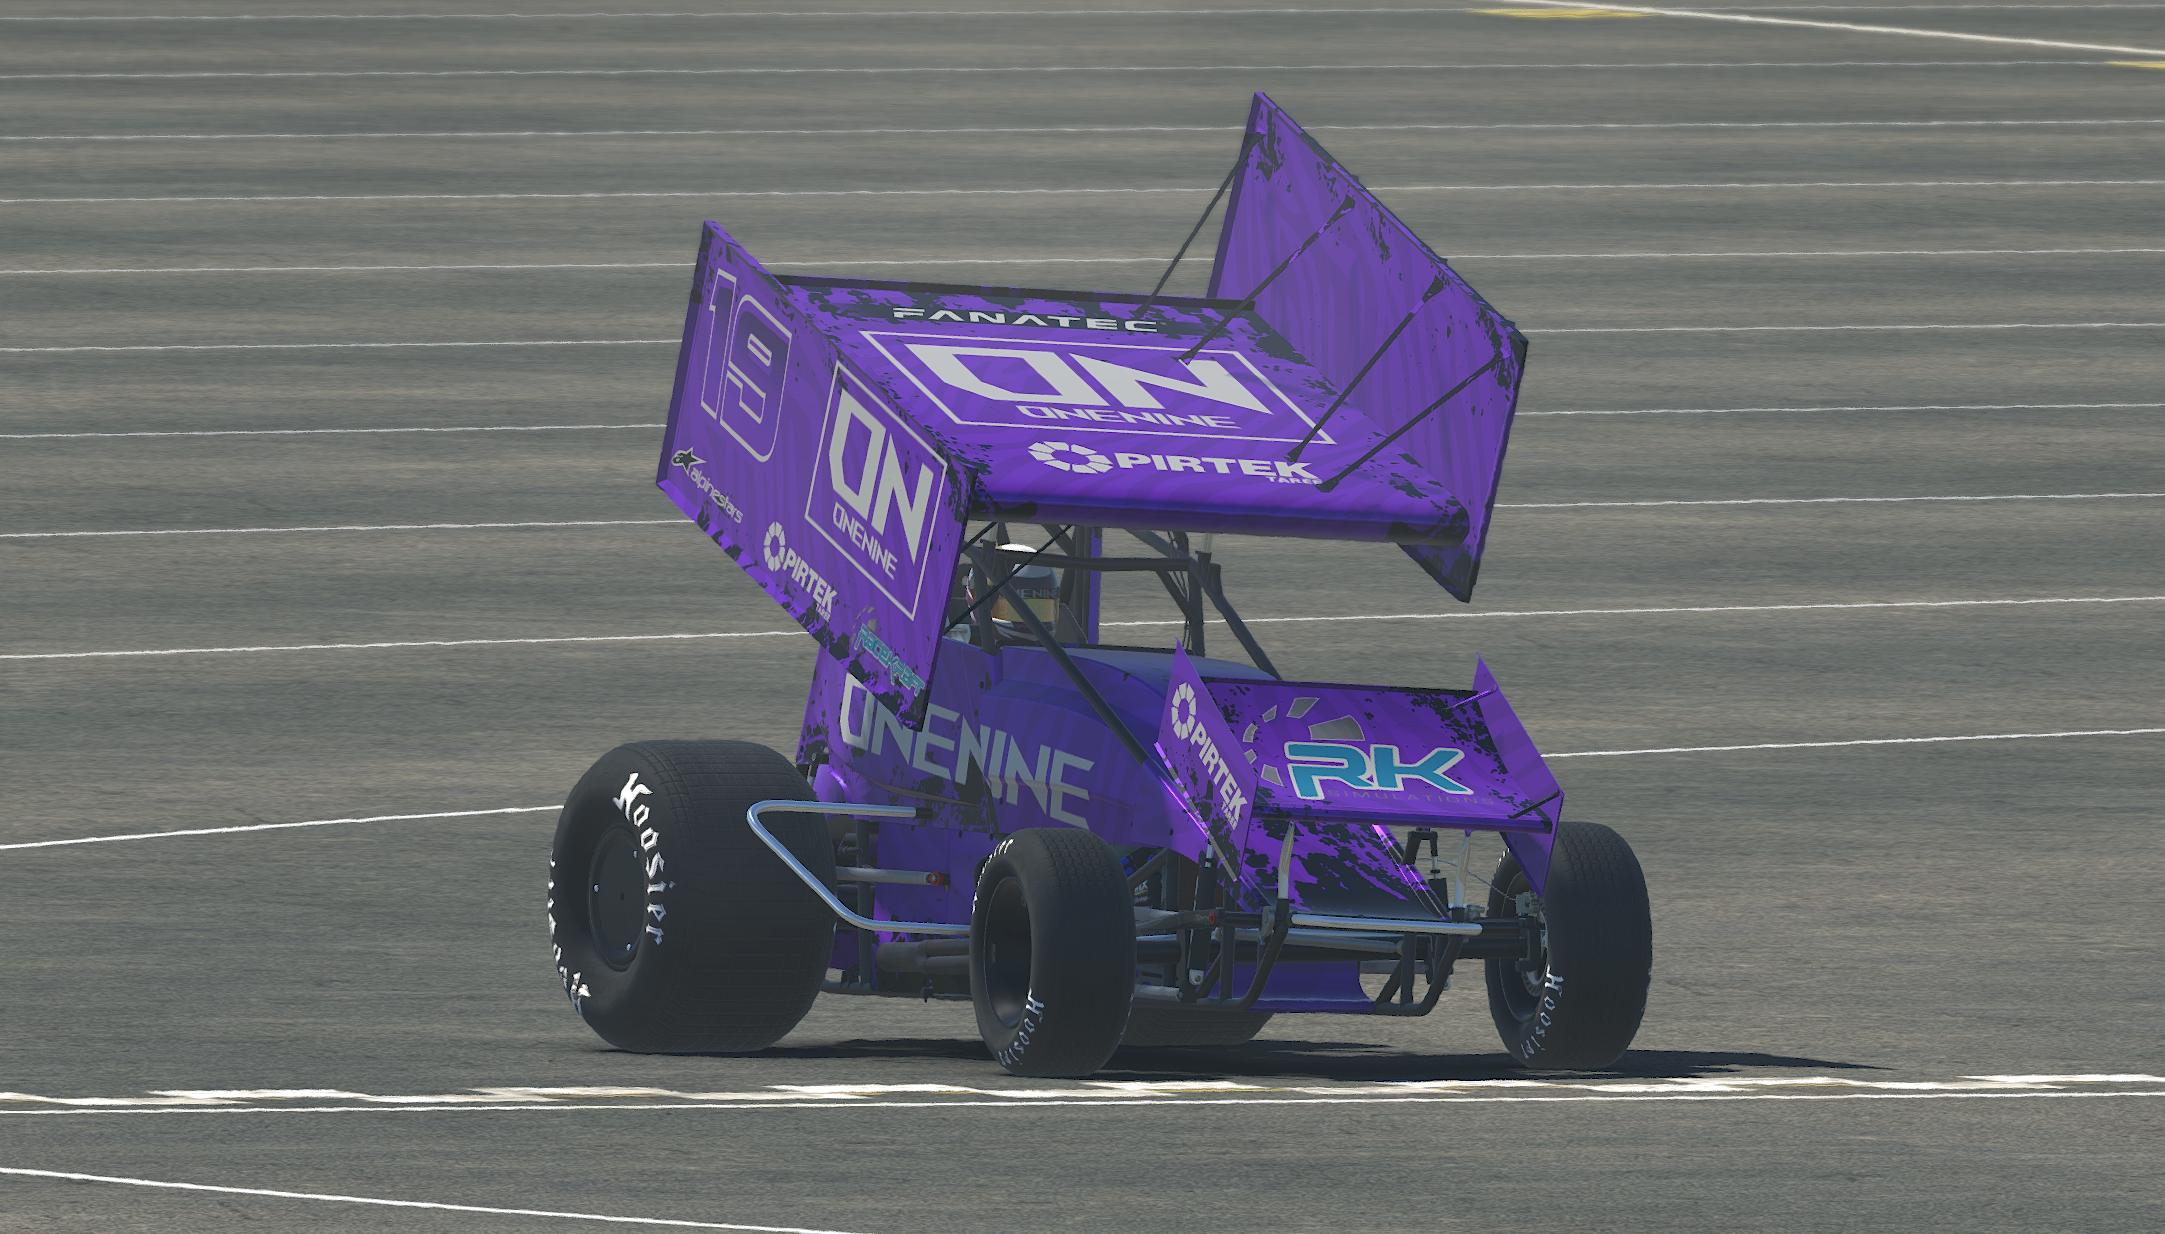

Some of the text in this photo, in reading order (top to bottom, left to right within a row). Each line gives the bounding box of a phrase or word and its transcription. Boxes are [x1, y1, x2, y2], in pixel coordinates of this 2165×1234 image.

[892, 306, 1158, 333] FANATEC
[701, 267, 793, 463] 19
[903, 343, 1274, 415] ON
[1015, 404, 1243, 430] ONENINE
[690, 467, 744, 524] alpinestars
[829, 388, 934, 567] ON
[1113, 451, 1322, 480] PIRTEK
[832, 502, 898, 580] ONENINE
[783, 547, 838, 613] PIRTEK
[840, 672, 1095, 830] ONENINE
[1190, 721, 1248, 822] PIRTEK
[1284, 741, 1474, 801] RK
[612, 772, 677, 947] Hoosier
